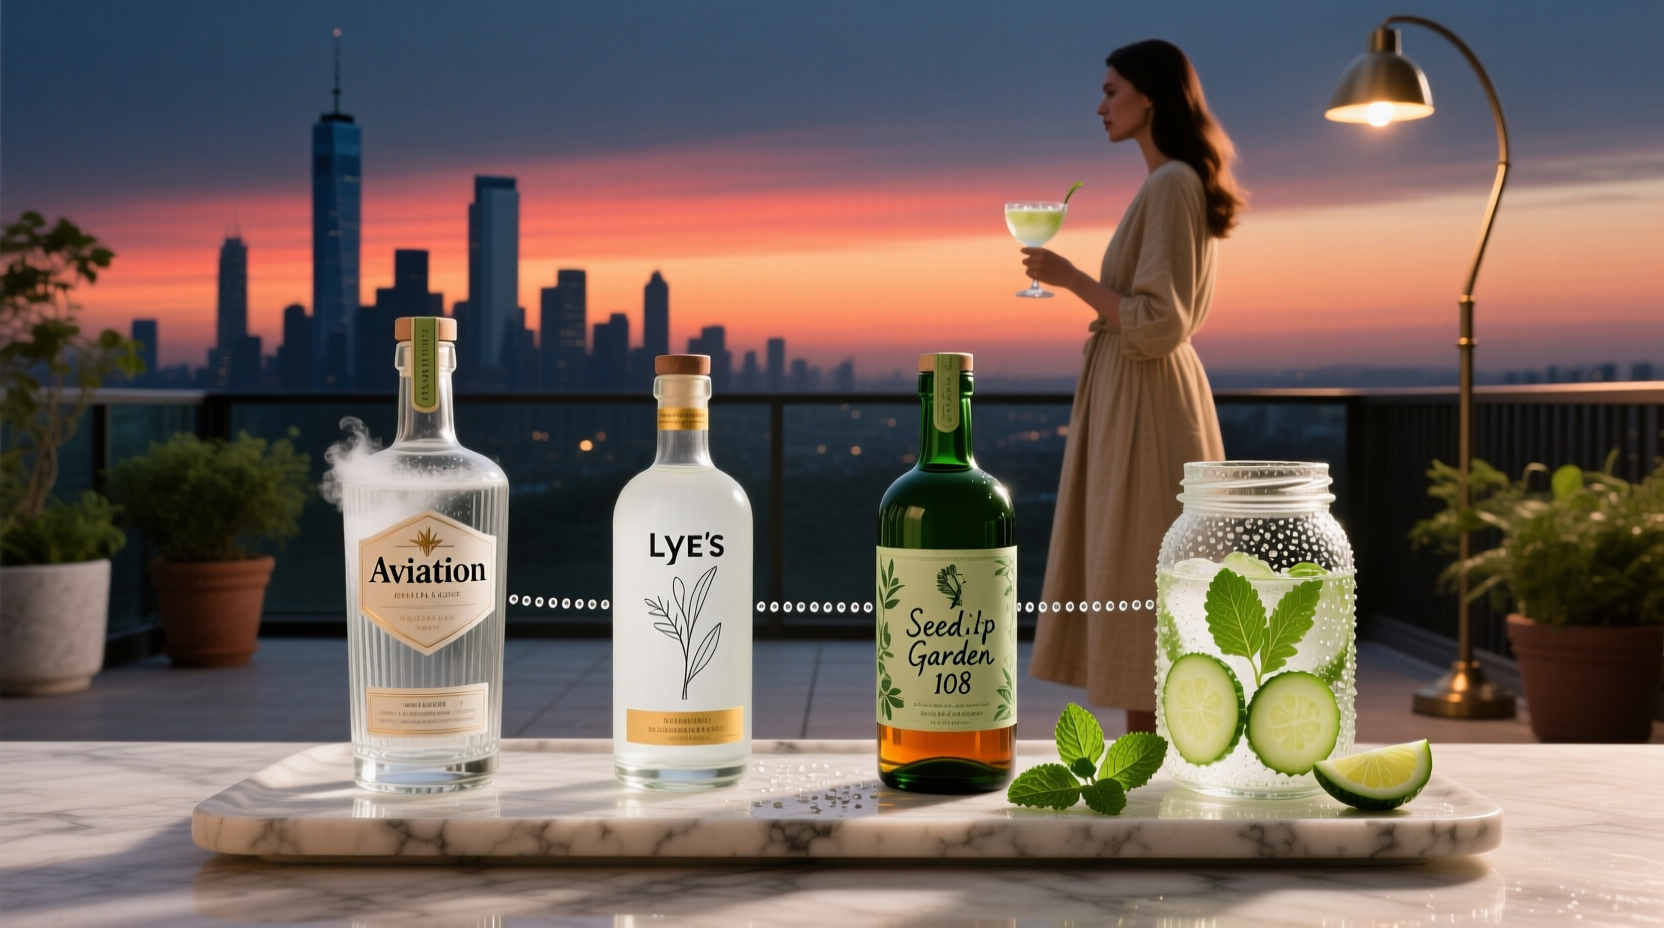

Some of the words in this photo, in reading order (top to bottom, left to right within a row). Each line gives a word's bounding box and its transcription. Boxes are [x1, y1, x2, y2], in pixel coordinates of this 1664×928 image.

[369, 557, 486, 584] Aviation
[908, 640, 995, 677] Garden
[934, 671, 971, 694] 108
